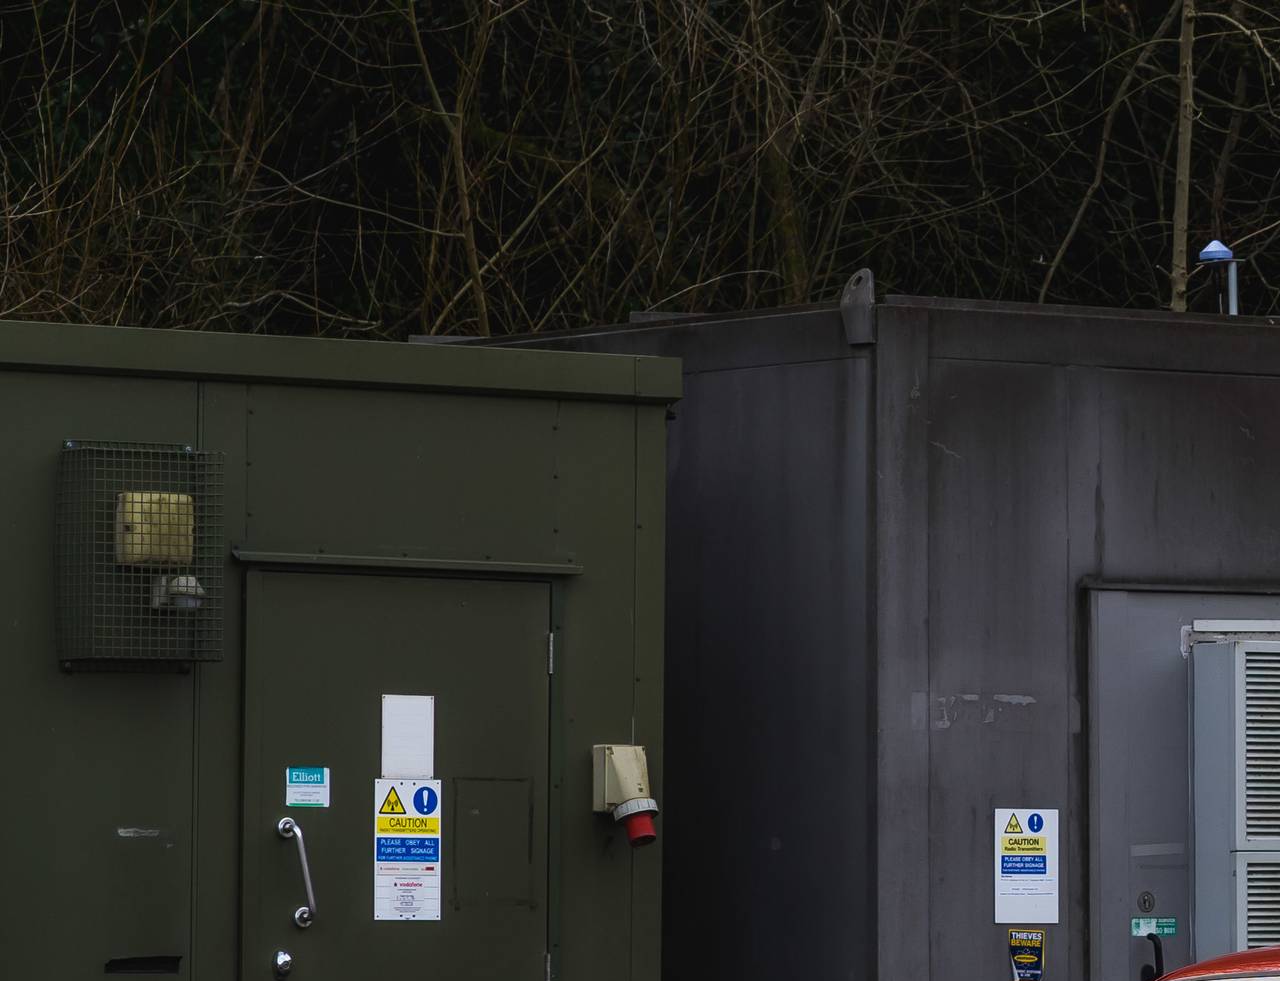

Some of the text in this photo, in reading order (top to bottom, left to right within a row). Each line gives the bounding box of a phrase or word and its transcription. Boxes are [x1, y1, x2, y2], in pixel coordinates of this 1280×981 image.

[292, 771, 321, 782] Elliott
[389, 818, 427, 828] CAUTION
[380, 838, 401, 846] PLEASE
[1008, 838, 1040, 846] CAUTION
[410, 847, 435, 855] SIGNAGE
[1011, 931, 1042, 940] THIEVES
[1011, 939, 1041, 947] BEWARE
